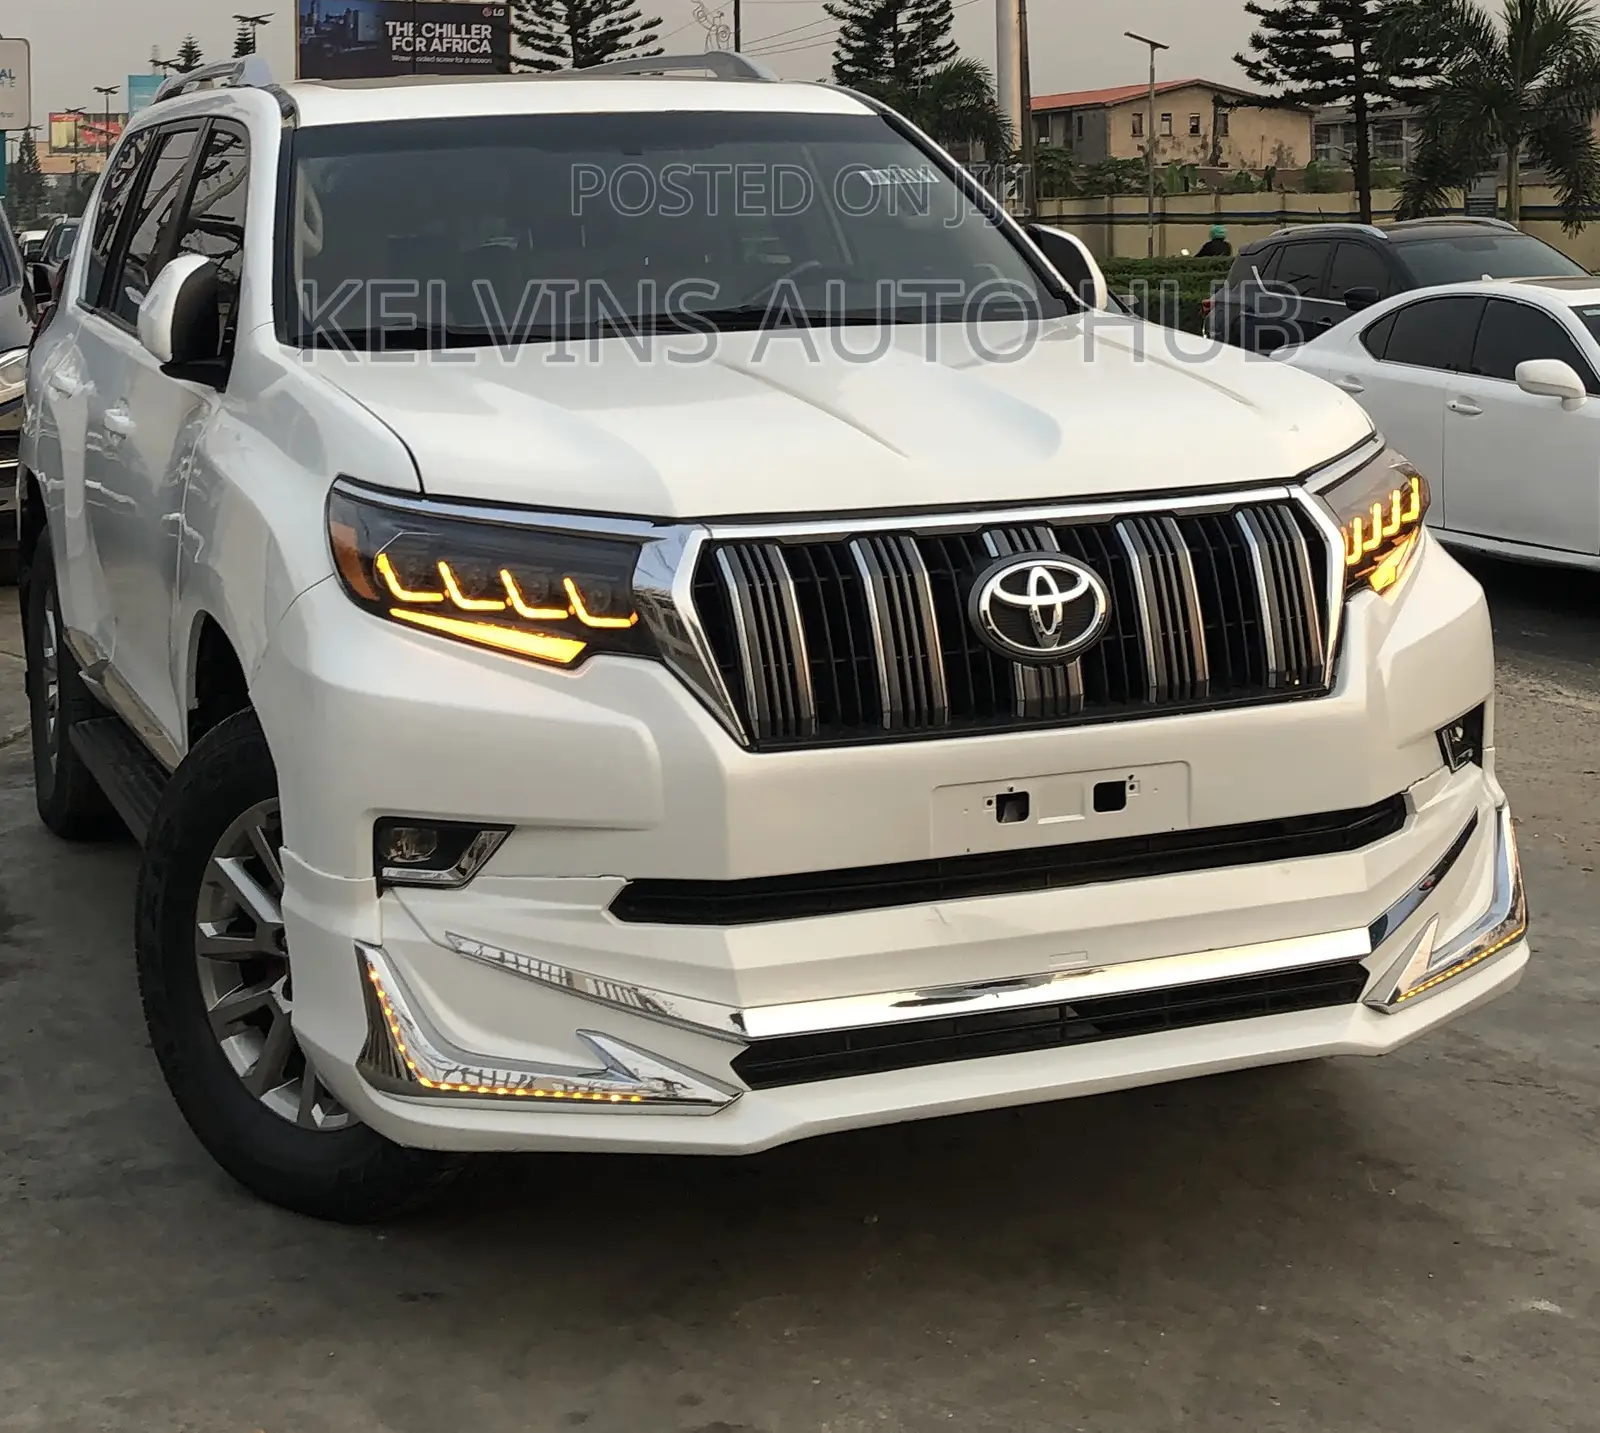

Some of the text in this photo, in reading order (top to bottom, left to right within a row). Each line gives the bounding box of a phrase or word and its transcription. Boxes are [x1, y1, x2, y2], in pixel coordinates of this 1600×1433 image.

[492, 8, 505, 17] LG
[421, 22, 492, 39] CHILLER
[391, 36, 492, 54] FOR AFRICA
